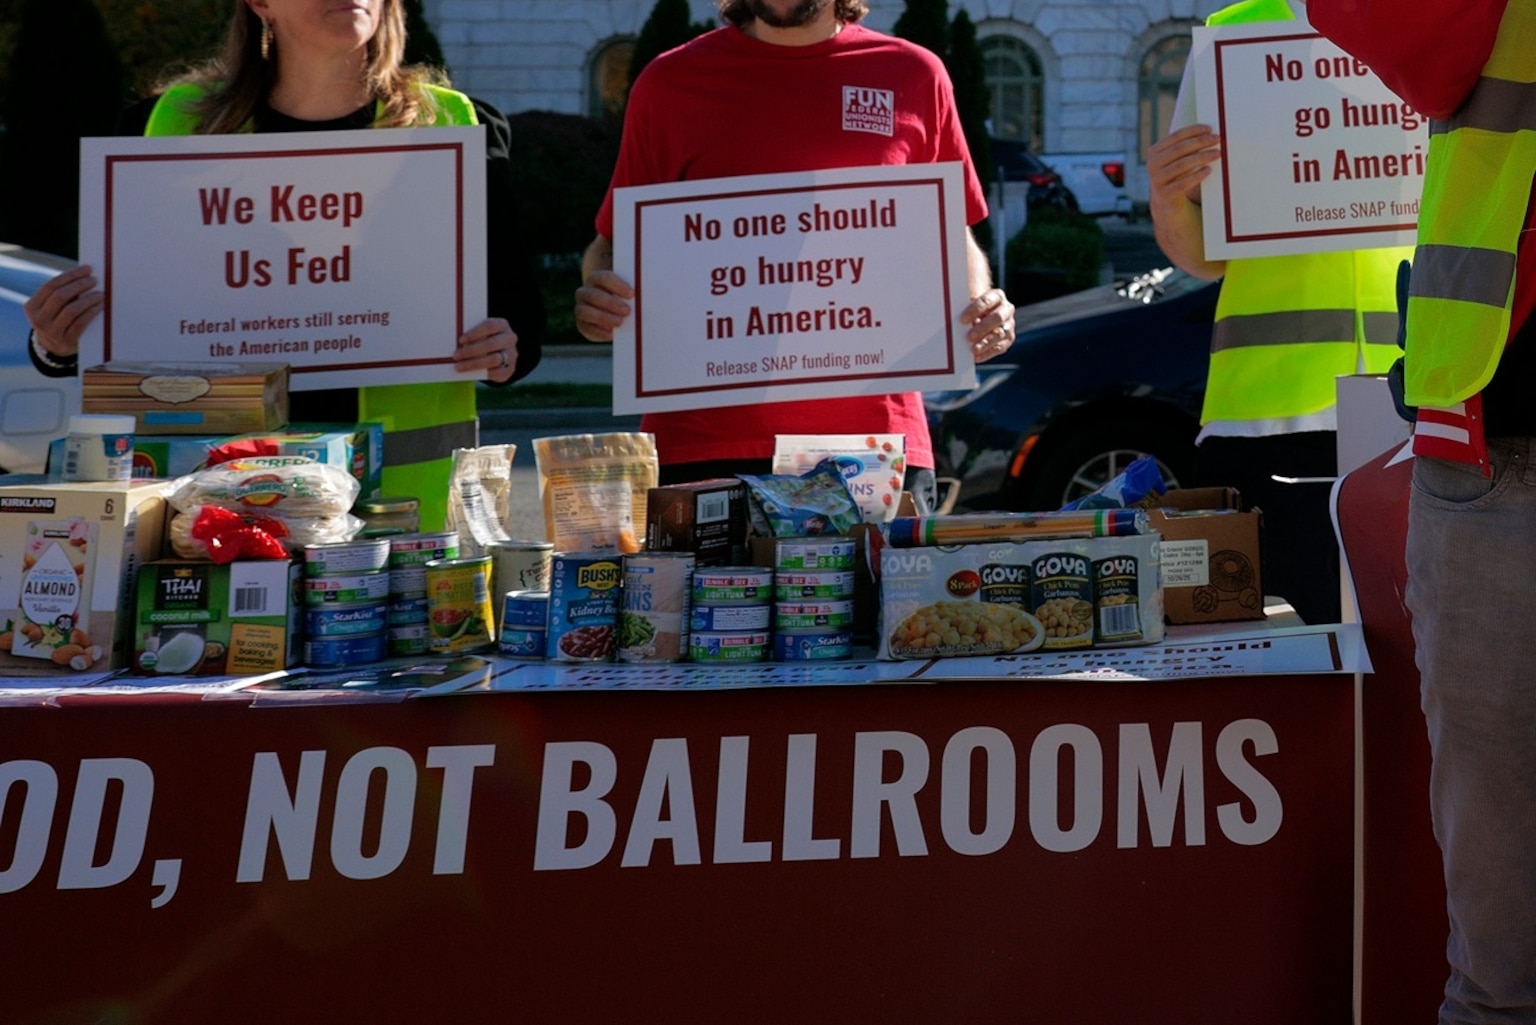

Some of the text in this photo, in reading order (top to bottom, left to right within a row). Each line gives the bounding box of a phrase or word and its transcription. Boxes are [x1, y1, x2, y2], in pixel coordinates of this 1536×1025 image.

[1265, 53, 1368, 83] No one
[845, 88, 890, 111] FUN
[1295, 107, 1330, 138] go
[1293, 146, 1428, 183] in Ameri
[200, 184, 363, 227] We Keep
[1295, 198, 1421, 223] Release SNAP fund
[684, 199, 897, 242] No one should
[225, 246, 351, 289] Us Fed
[710, 256, 865, 296] go hungry
[180, 311, 390, 335] Federal workers still serving
[706, 301, 882, 340] in America.
[209, 335, 362, 357] the American people
[706, 349, 885, 377] Release SNAP funding now!
[1, 498, 54, 507] KIRKLAND
[105, 499, 114, 514] 6
[1036, 558, 1086, 577] GOYA
[1099, 560, 1136, 576] OYA
[25, 582, 76, 596] ALMOND
[161, 578, 202, 594] THAI
[150, 611, 212, 622] coconut milk
[569, 606, 602, 618] Kidney
[239, 648, 265, 657] baking
[236, 744, 496, 883] NOT
[532, 718, 1284, 872] BALLROOMS
